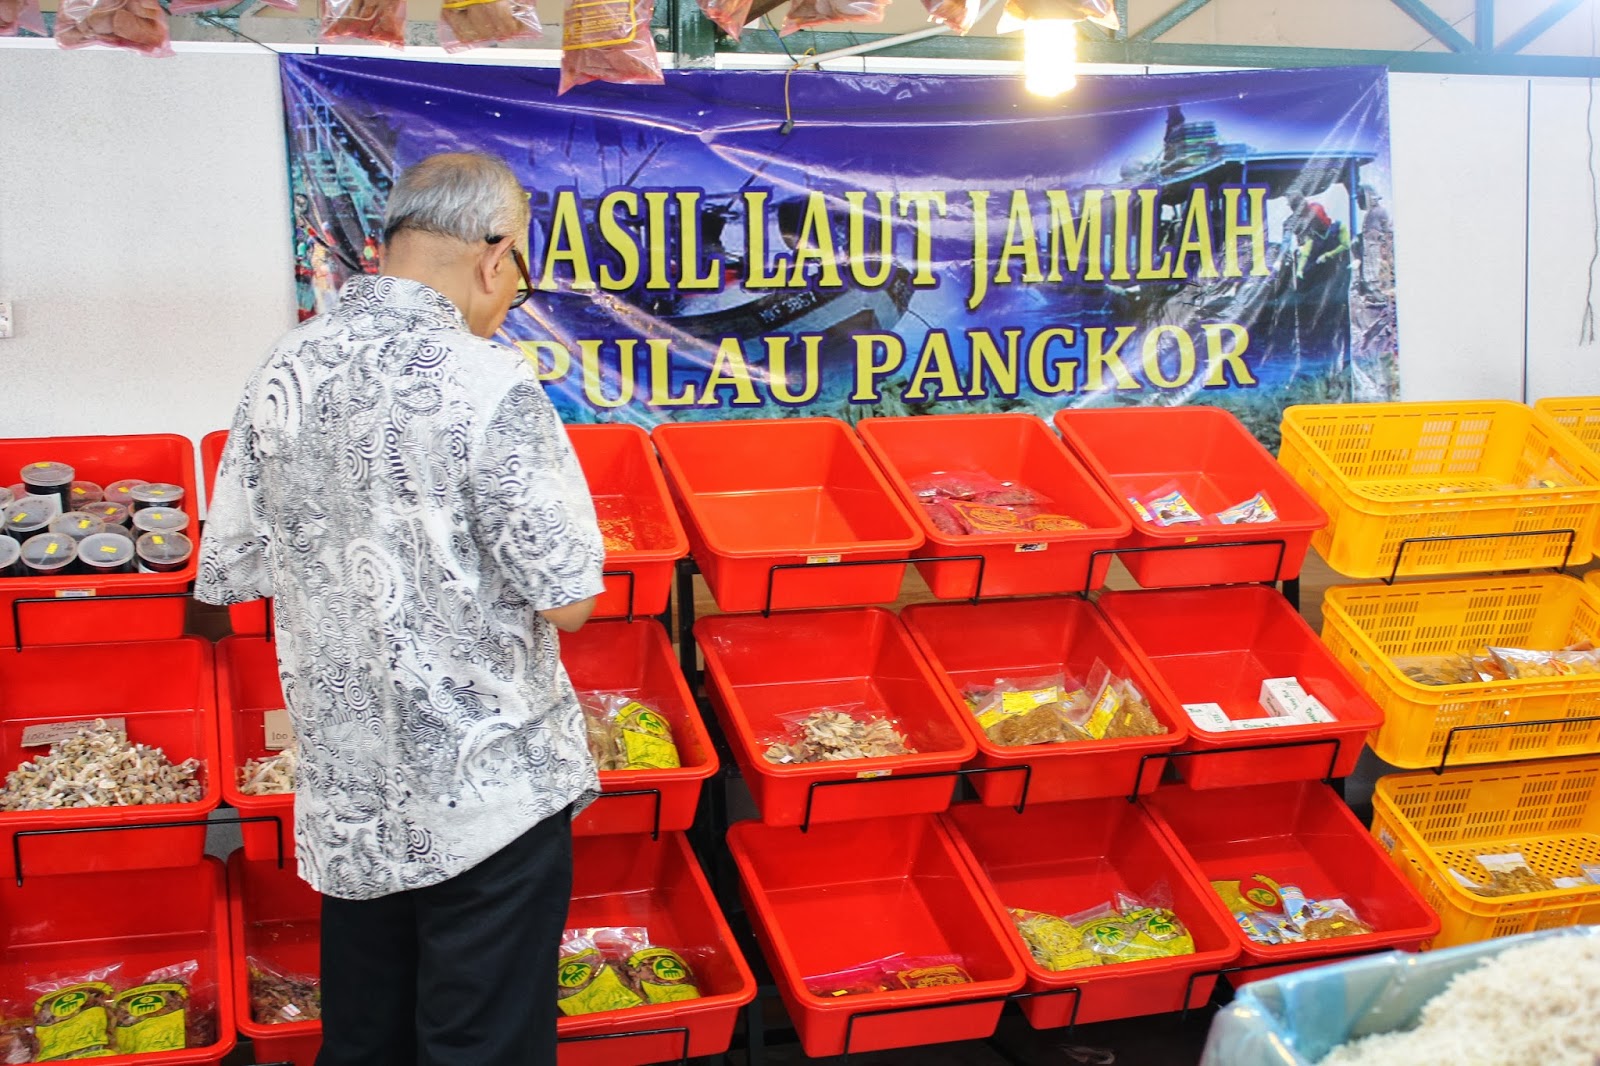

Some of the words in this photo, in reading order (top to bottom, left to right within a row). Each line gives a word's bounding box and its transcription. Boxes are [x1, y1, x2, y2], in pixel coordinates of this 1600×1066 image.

[743, 190, 947, 287] LAUT
[967, 187, 1270, 309] JAMILAH
[519, 336, 823, 407] PULAU
[851, 322, 1256, 400] PANGKOR
[271, 731, 288, 741] 100
